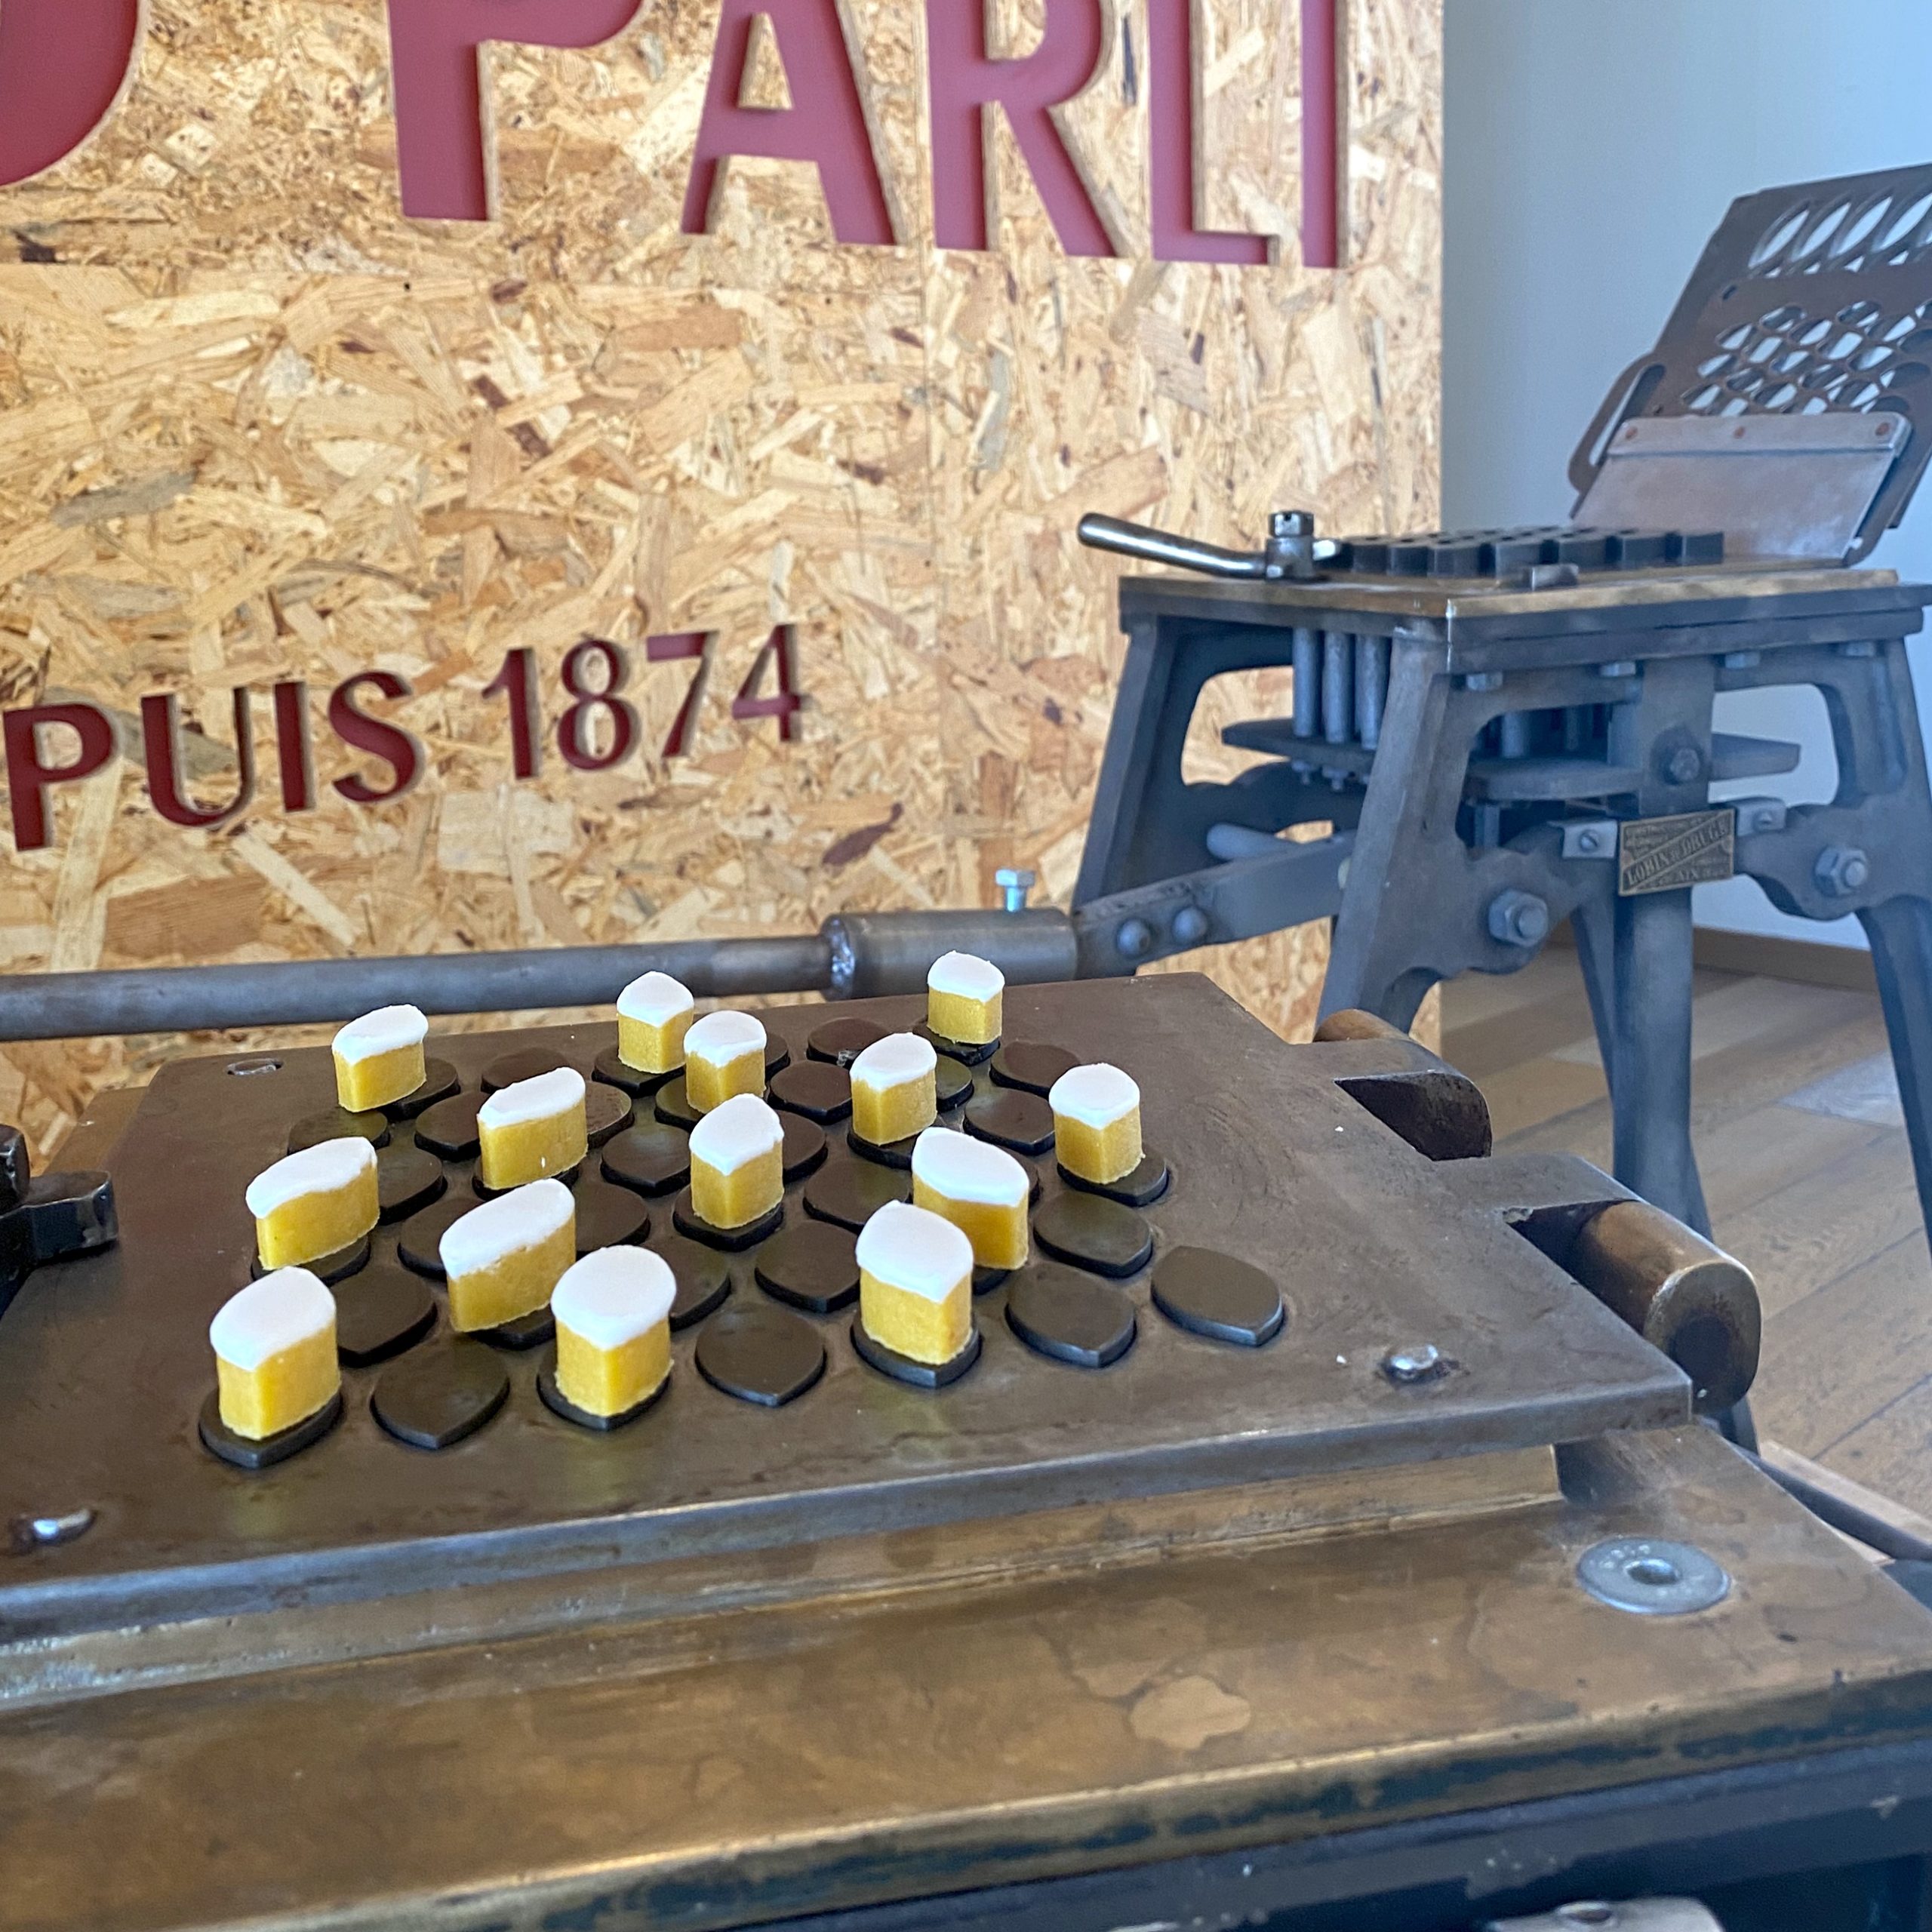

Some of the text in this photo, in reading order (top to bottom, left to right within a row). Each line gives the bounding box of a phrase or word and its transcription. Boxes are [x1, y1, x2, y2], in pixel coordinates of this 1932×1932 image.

[392, 0, 1340, 269] PARLI
[3, 623, 804, 851] PUIS 1874
